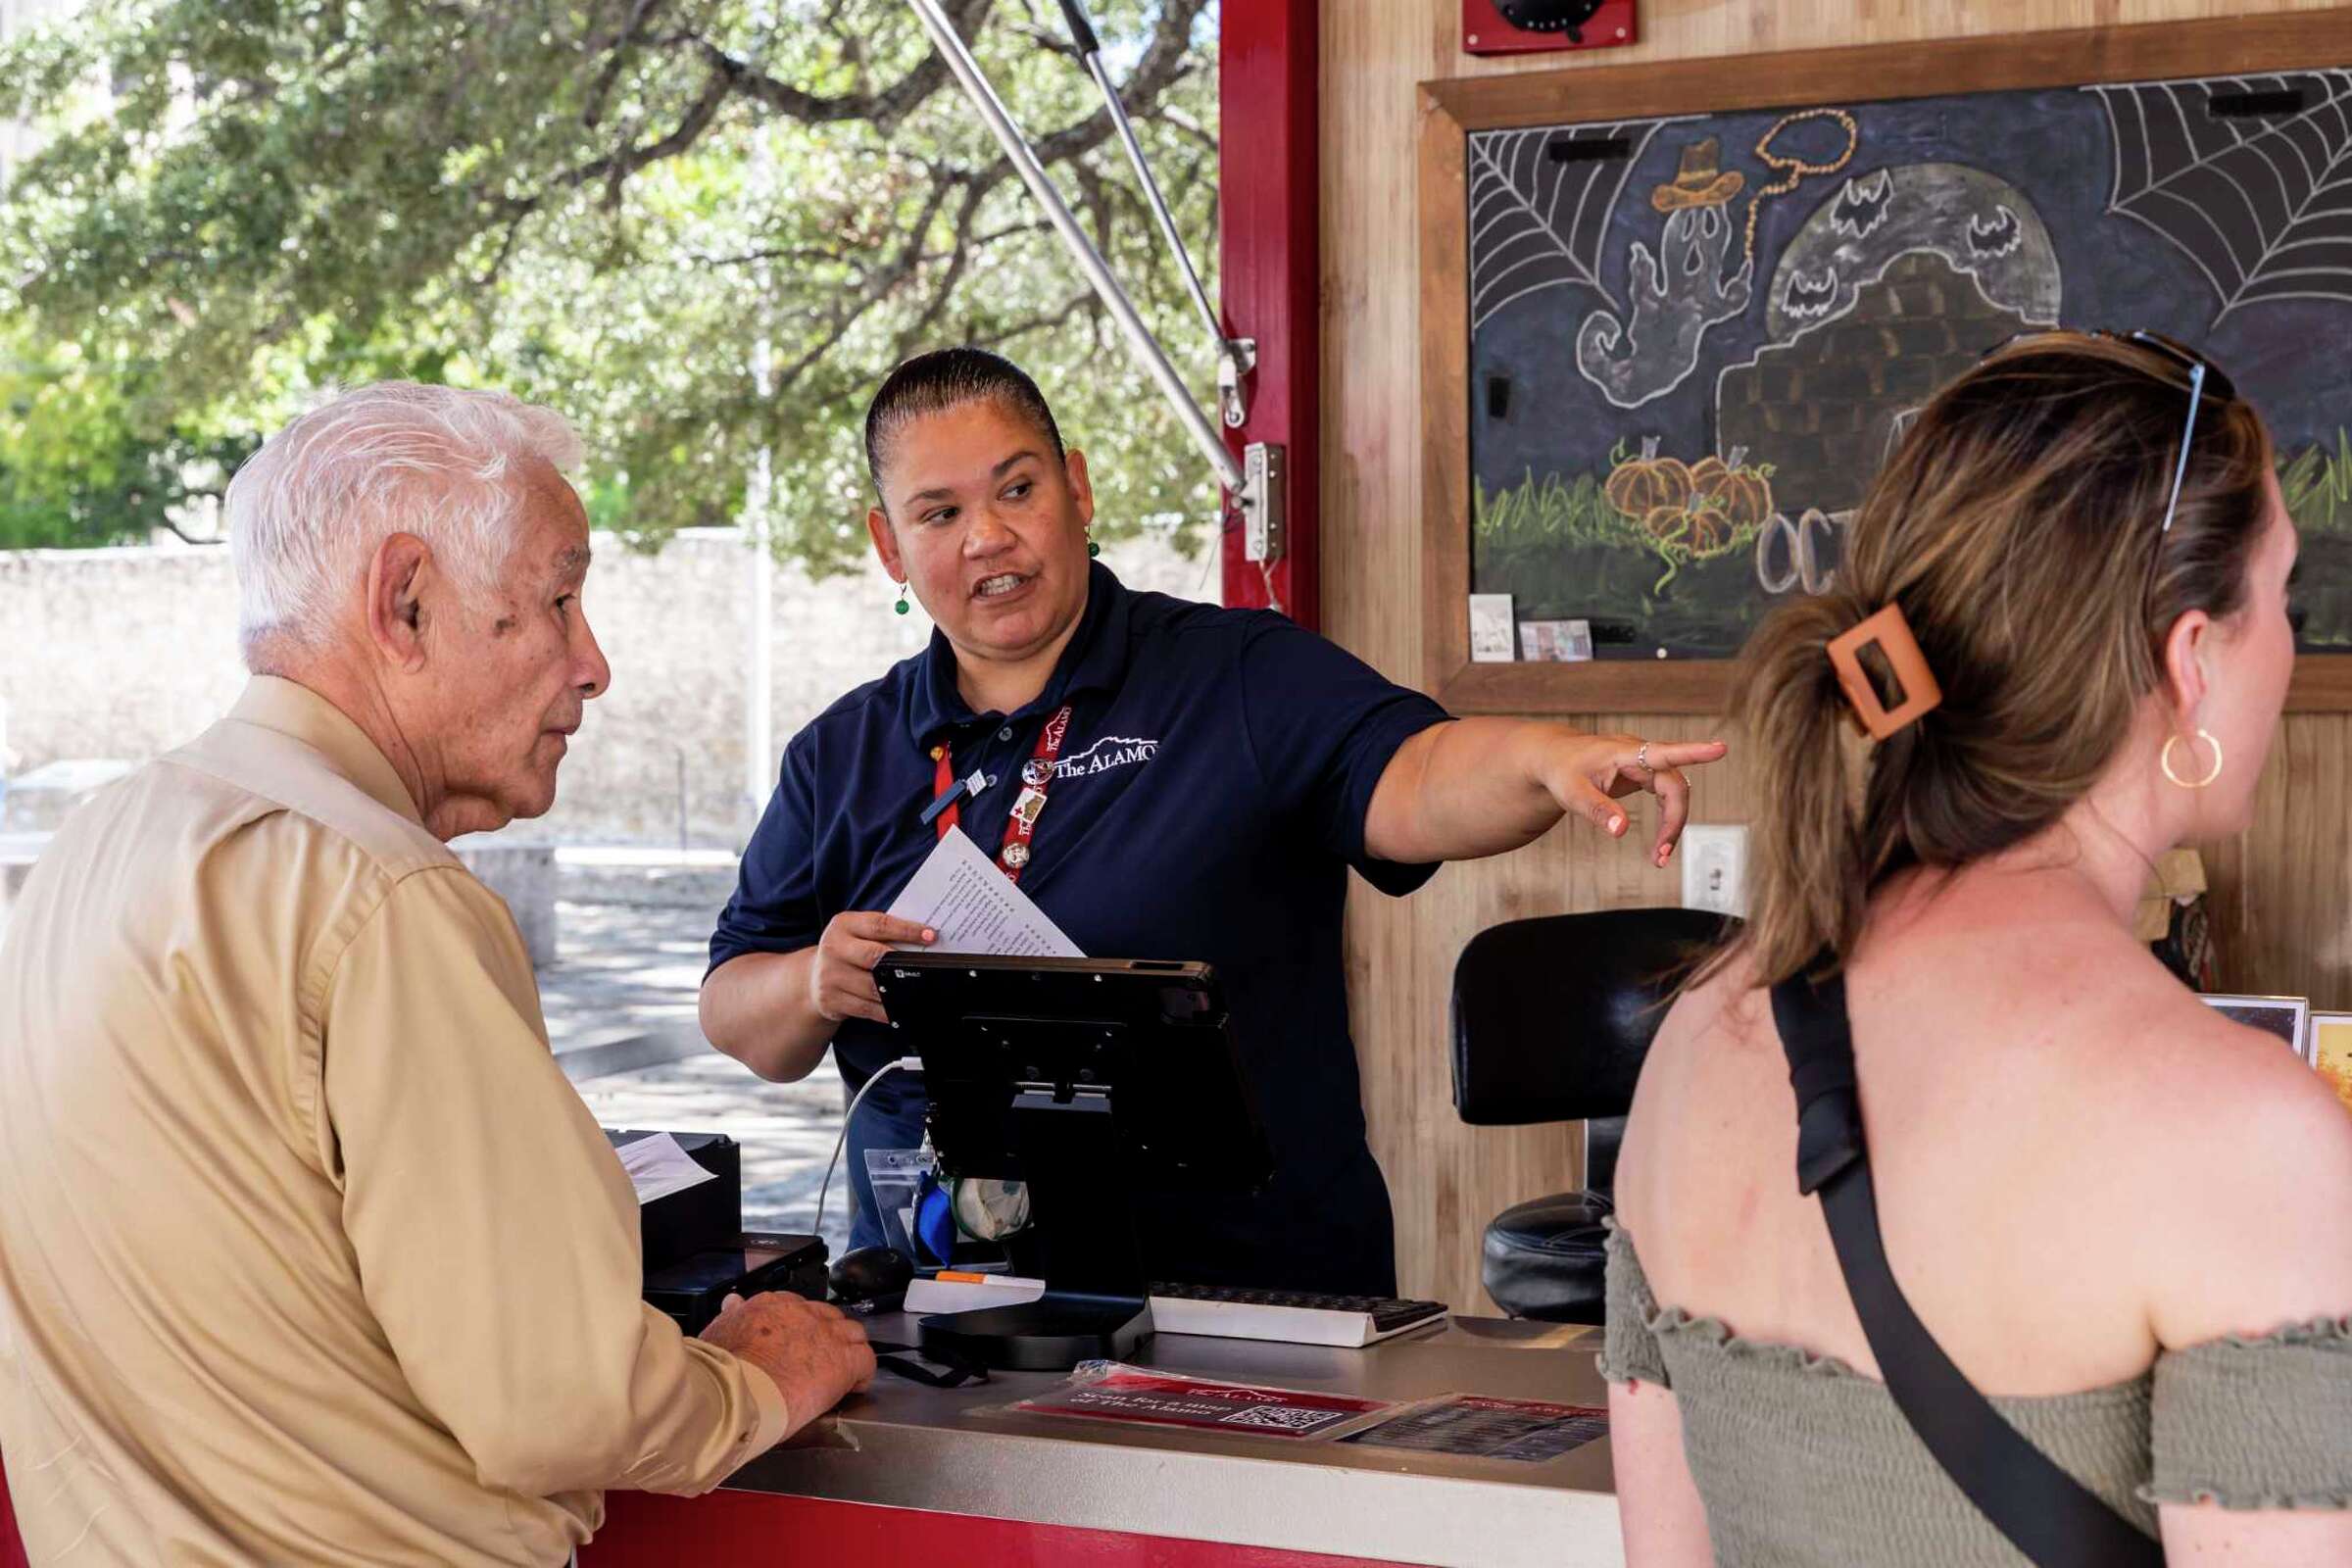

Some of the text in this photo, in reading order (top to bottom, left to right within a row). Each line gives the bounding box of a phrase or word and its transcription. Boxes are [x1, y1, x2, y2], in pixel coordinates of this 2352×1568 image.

[1049, 738, 1059, 752] The
[1056, 744, 1155, 778] The ALAMO
[1132, 1396, 1165, 1404] for
